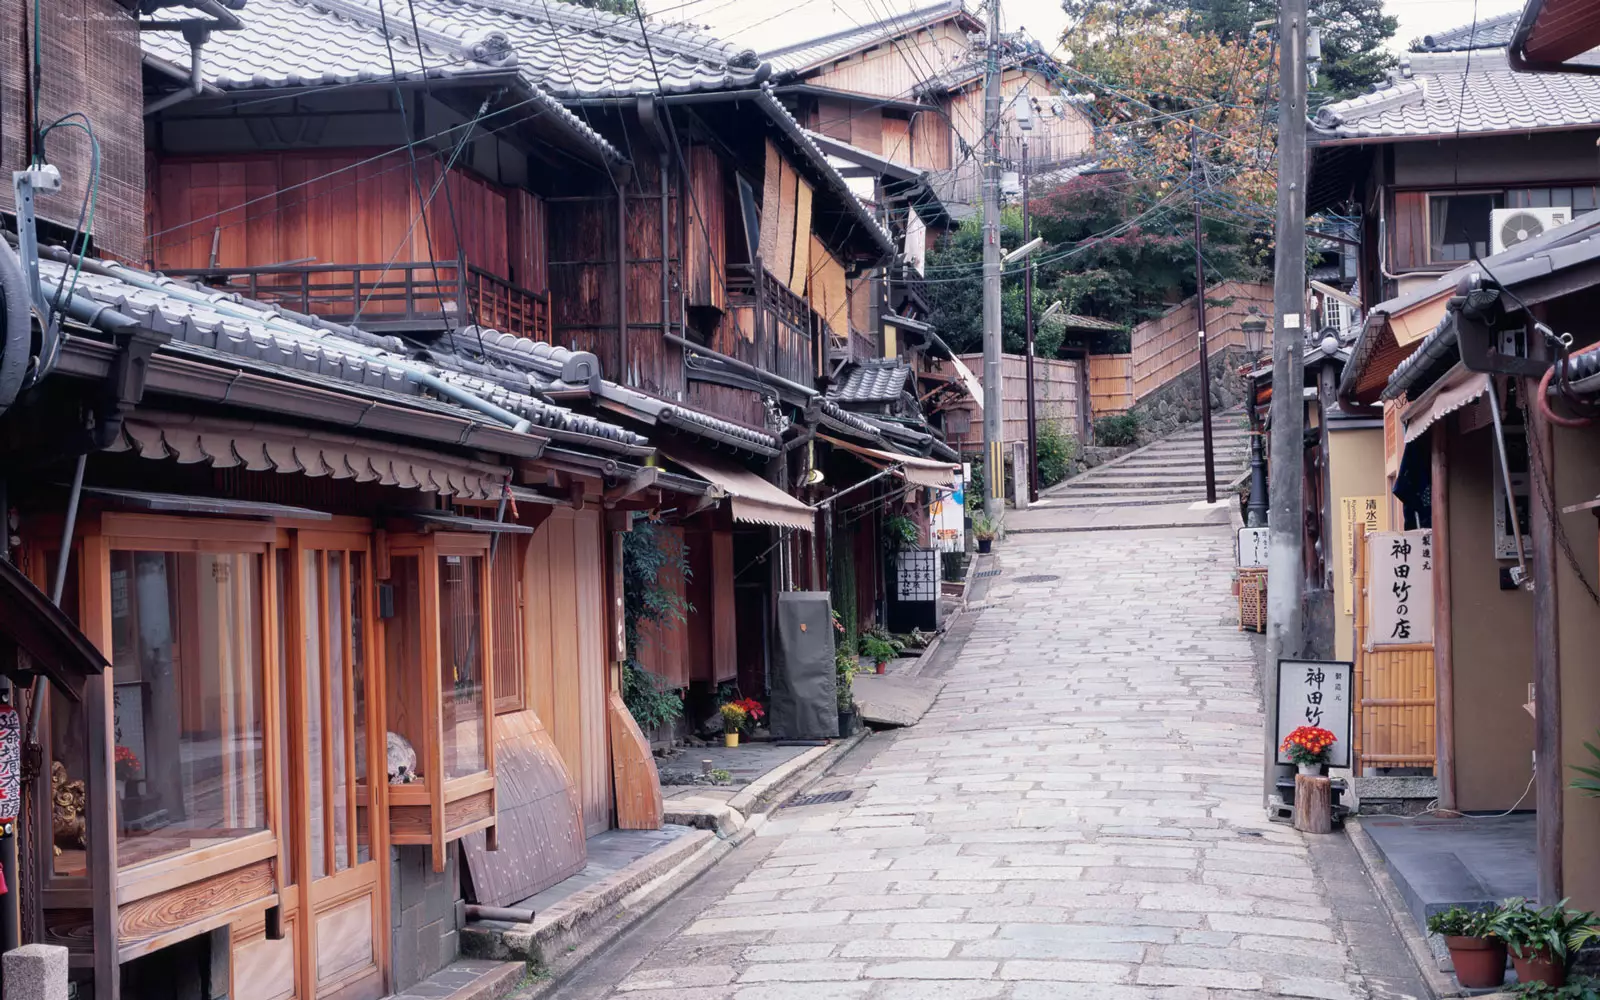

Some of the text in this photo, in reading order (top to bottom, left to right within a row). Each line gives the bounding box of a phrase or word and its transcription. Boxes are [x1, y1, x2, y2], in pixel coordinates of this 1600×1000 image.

[1366, 499, 1377, 531] 清水三
[1422, 535, 1432, 571] 製造元
[1390, 539, 1412, 639] 神田竹の店
[1304, 667, 1325, 727] 神田竹
[1334, 672, 1342, 701] 製造元
